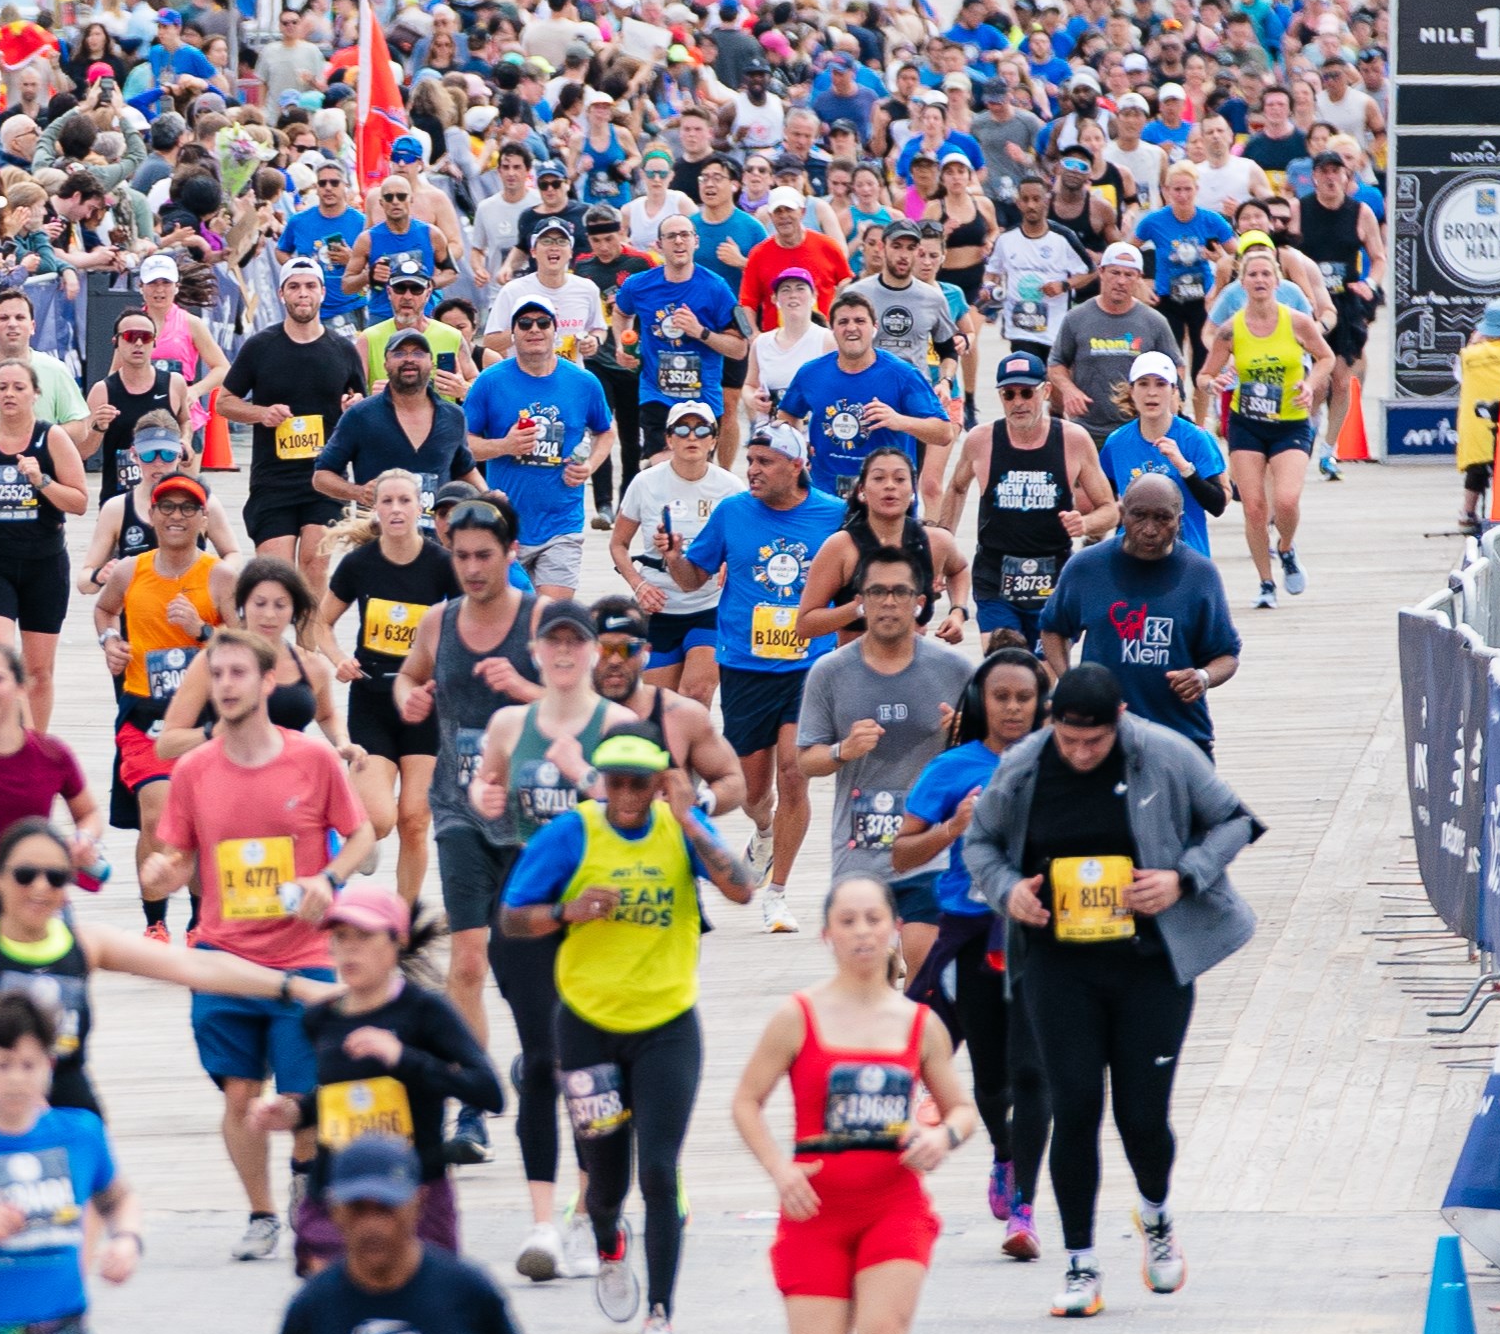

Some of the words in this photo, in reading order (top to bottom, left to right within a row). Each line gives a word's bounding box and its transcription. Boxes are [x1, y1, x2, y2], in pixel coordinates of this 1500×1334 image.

[1008, 470, 1047, 484] DEFINE
[997, 483, 1023, 497] NEW
[1025, 483, 1057, 497] YORK
[1000, 496, 1023, 509] RUN
[1025, 496, 1055, 510] CLUB
[1014, 575, 1052, 592] 36733
[1122, 639, 1169, 665] Klein
[620, 887, 675, 907] EAM
[1080, 885, 1120, 908] 8151
[616, 907, 673, 928] KIDS
